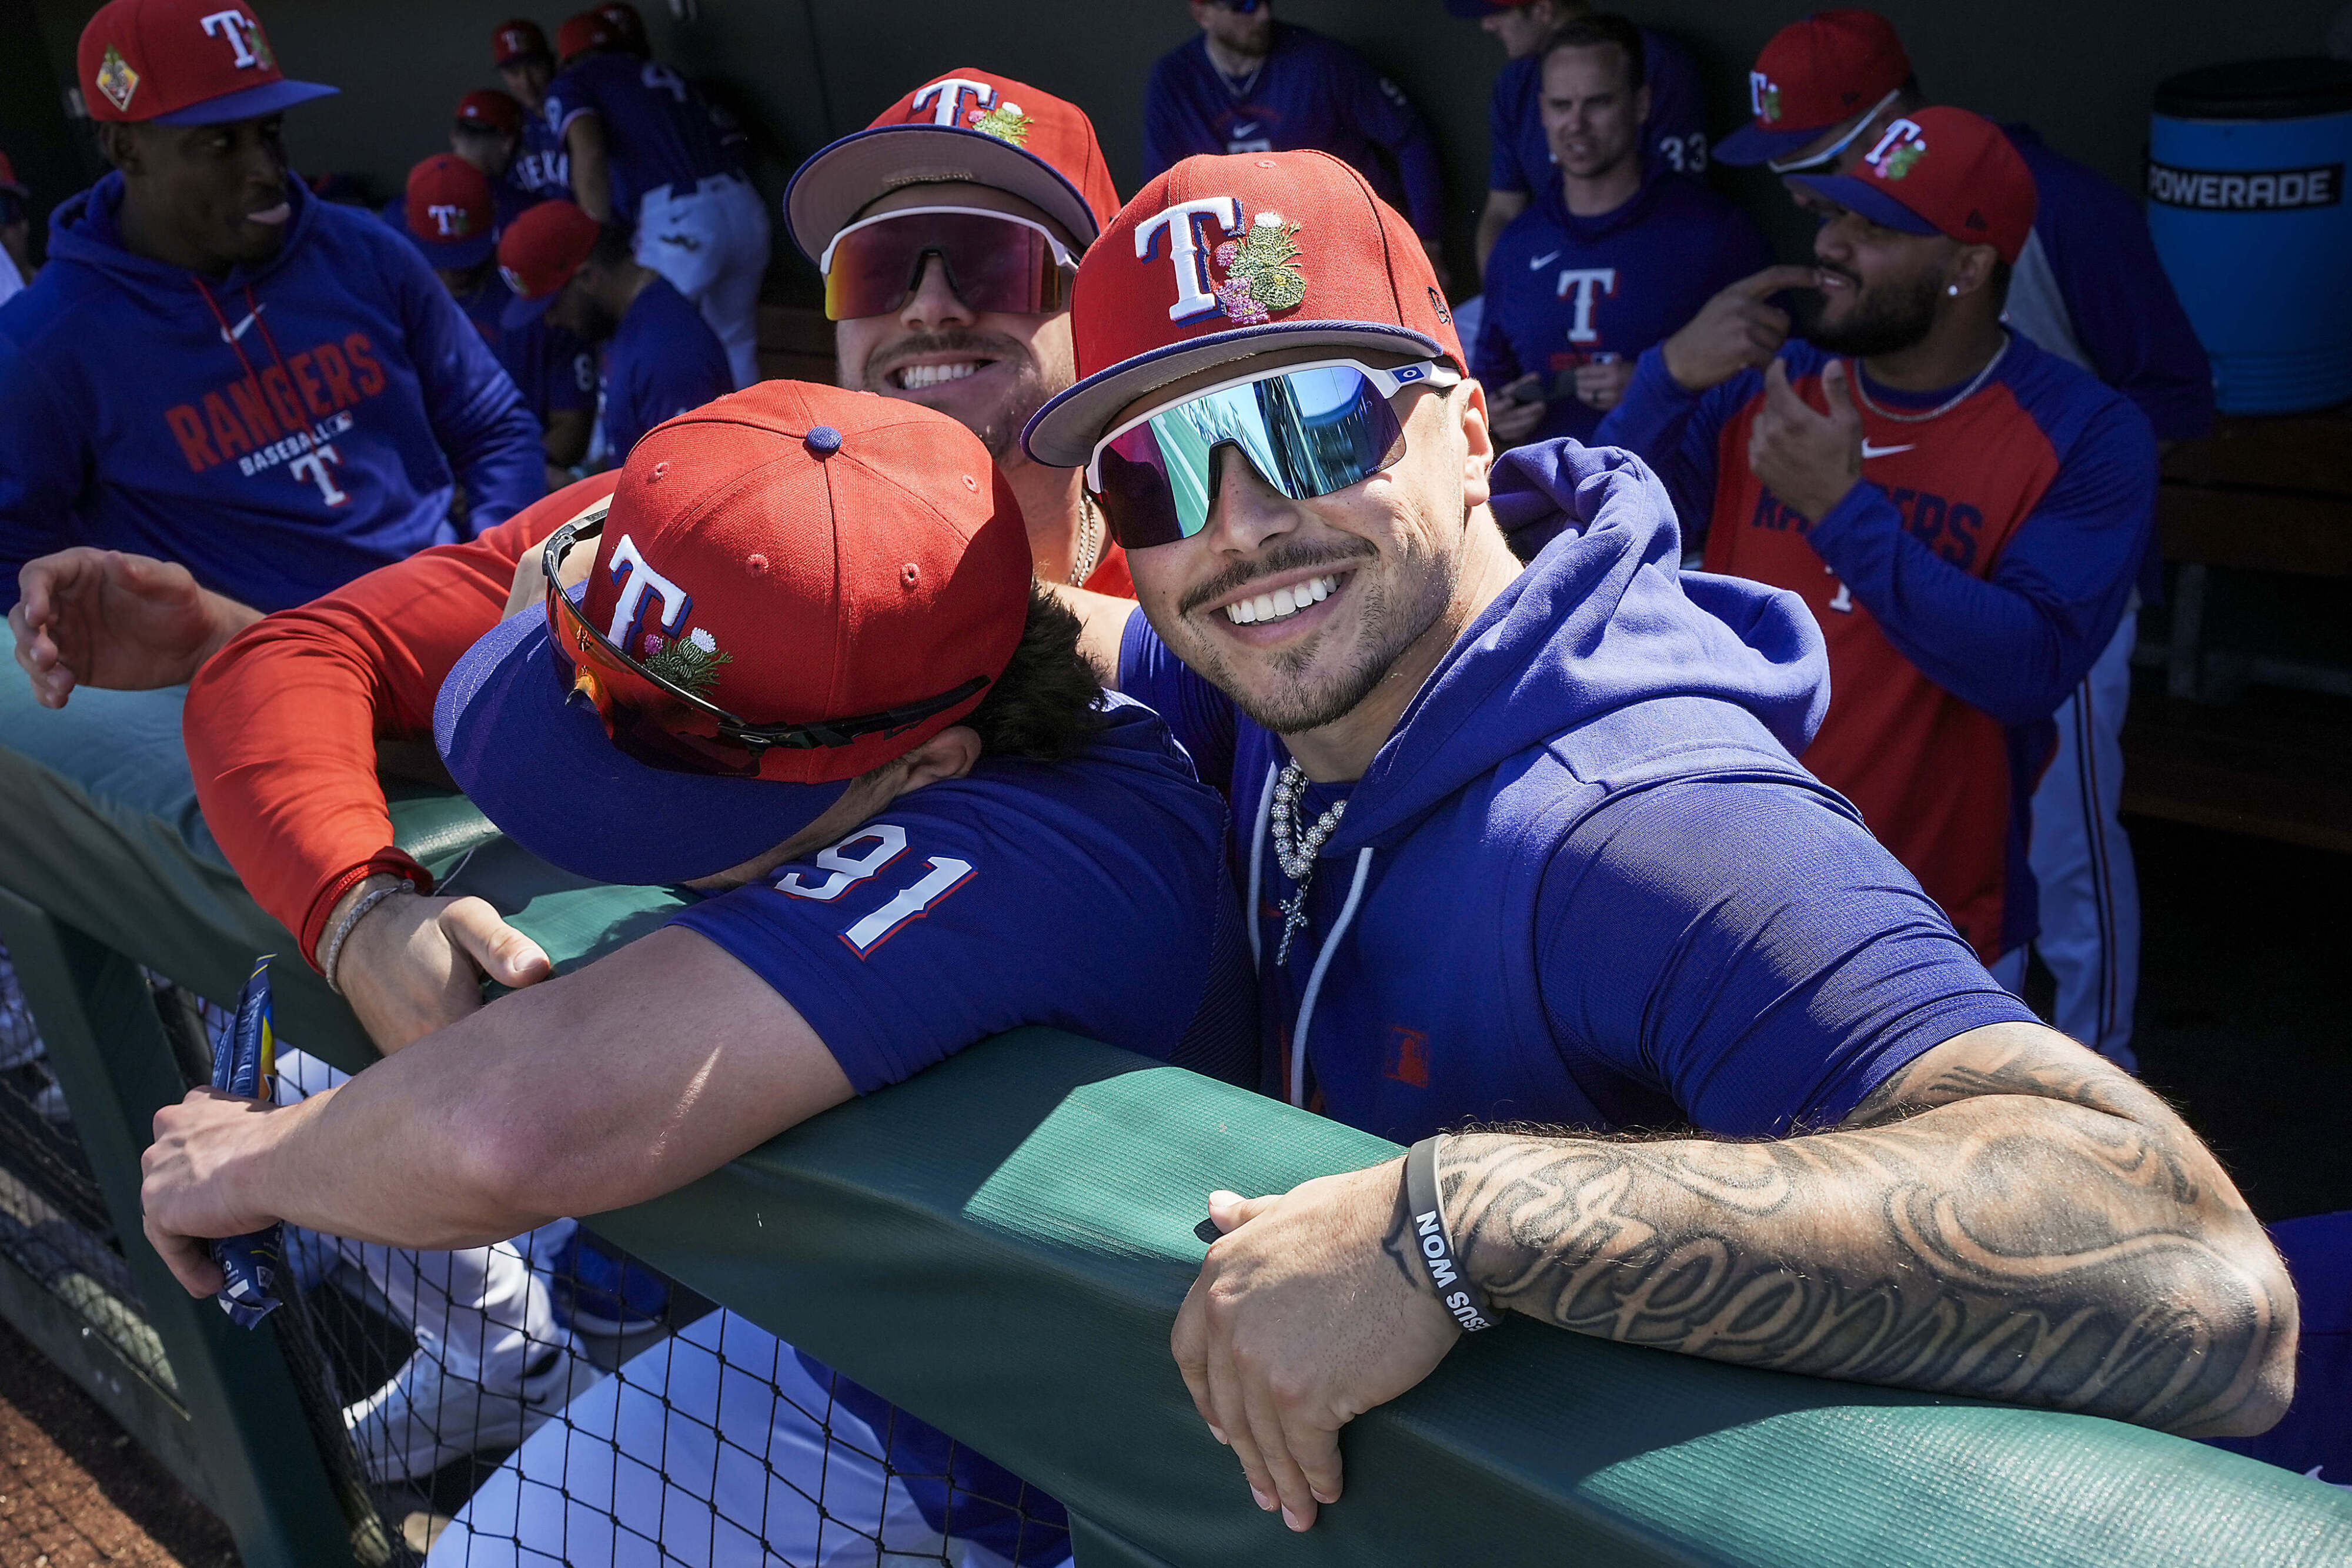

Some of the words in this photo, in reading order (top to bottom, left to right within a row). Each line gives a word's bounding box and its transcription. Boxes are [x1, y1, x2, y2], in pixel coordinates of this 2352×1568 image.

[201, 9, 256, 69] T
[913, 79, 998, 126] T
[1135, 196, 1245, 327] T
[1557, 268, 1621, 346] T
[165, 333, 386, 472] RANGERS
[238, 417, 330, 477] BASEBALL
[289, 444, 351, 507] T
[609, 534, 693, 653] T
[775, 824, 978, 961] 91
[1415, 1209, 1458, 1289] WON
[1445, 1290, 1492, 1332] ESUS
